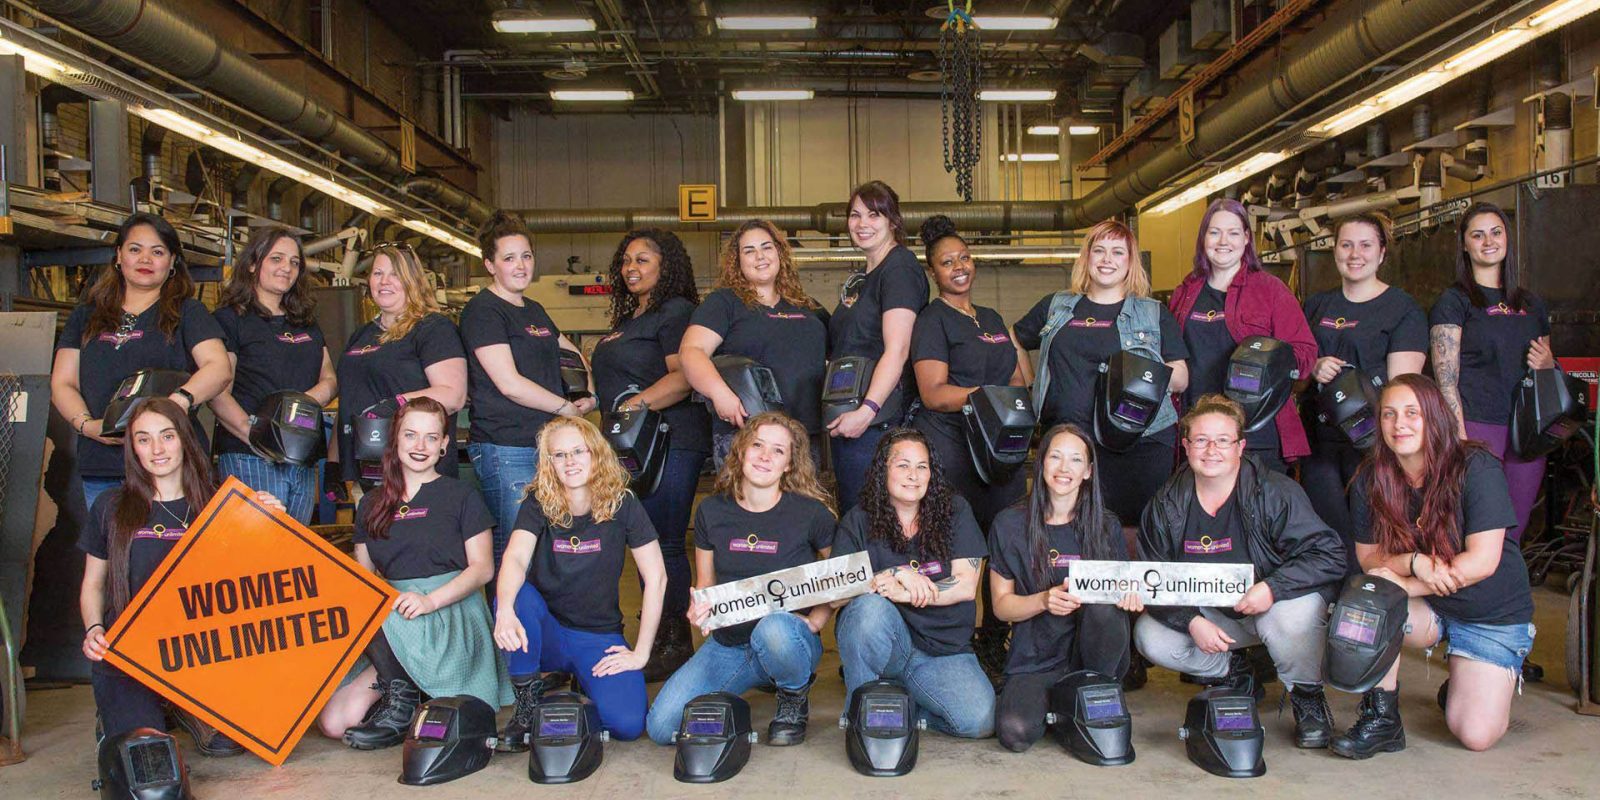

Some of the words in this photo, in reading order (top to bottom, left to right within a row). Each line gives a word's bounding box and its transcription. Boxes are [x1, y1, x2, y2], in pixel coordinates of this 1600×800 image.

[1182, 95, 1191, 136] S
[402, 126, 414, 165] N
[1542, 173, 1560, 186] 16
[688, 190, 709, 217] E
[178, 565, 319, 621] WOMEN
[709, 592, 767, 618] women
[790, 566, 868, 598] unlimited
[1075, 578, 1140, 592] women
[1165, 577, 1247, 594] unlimited
[158, 606, 350, 672] UNLIMITED
